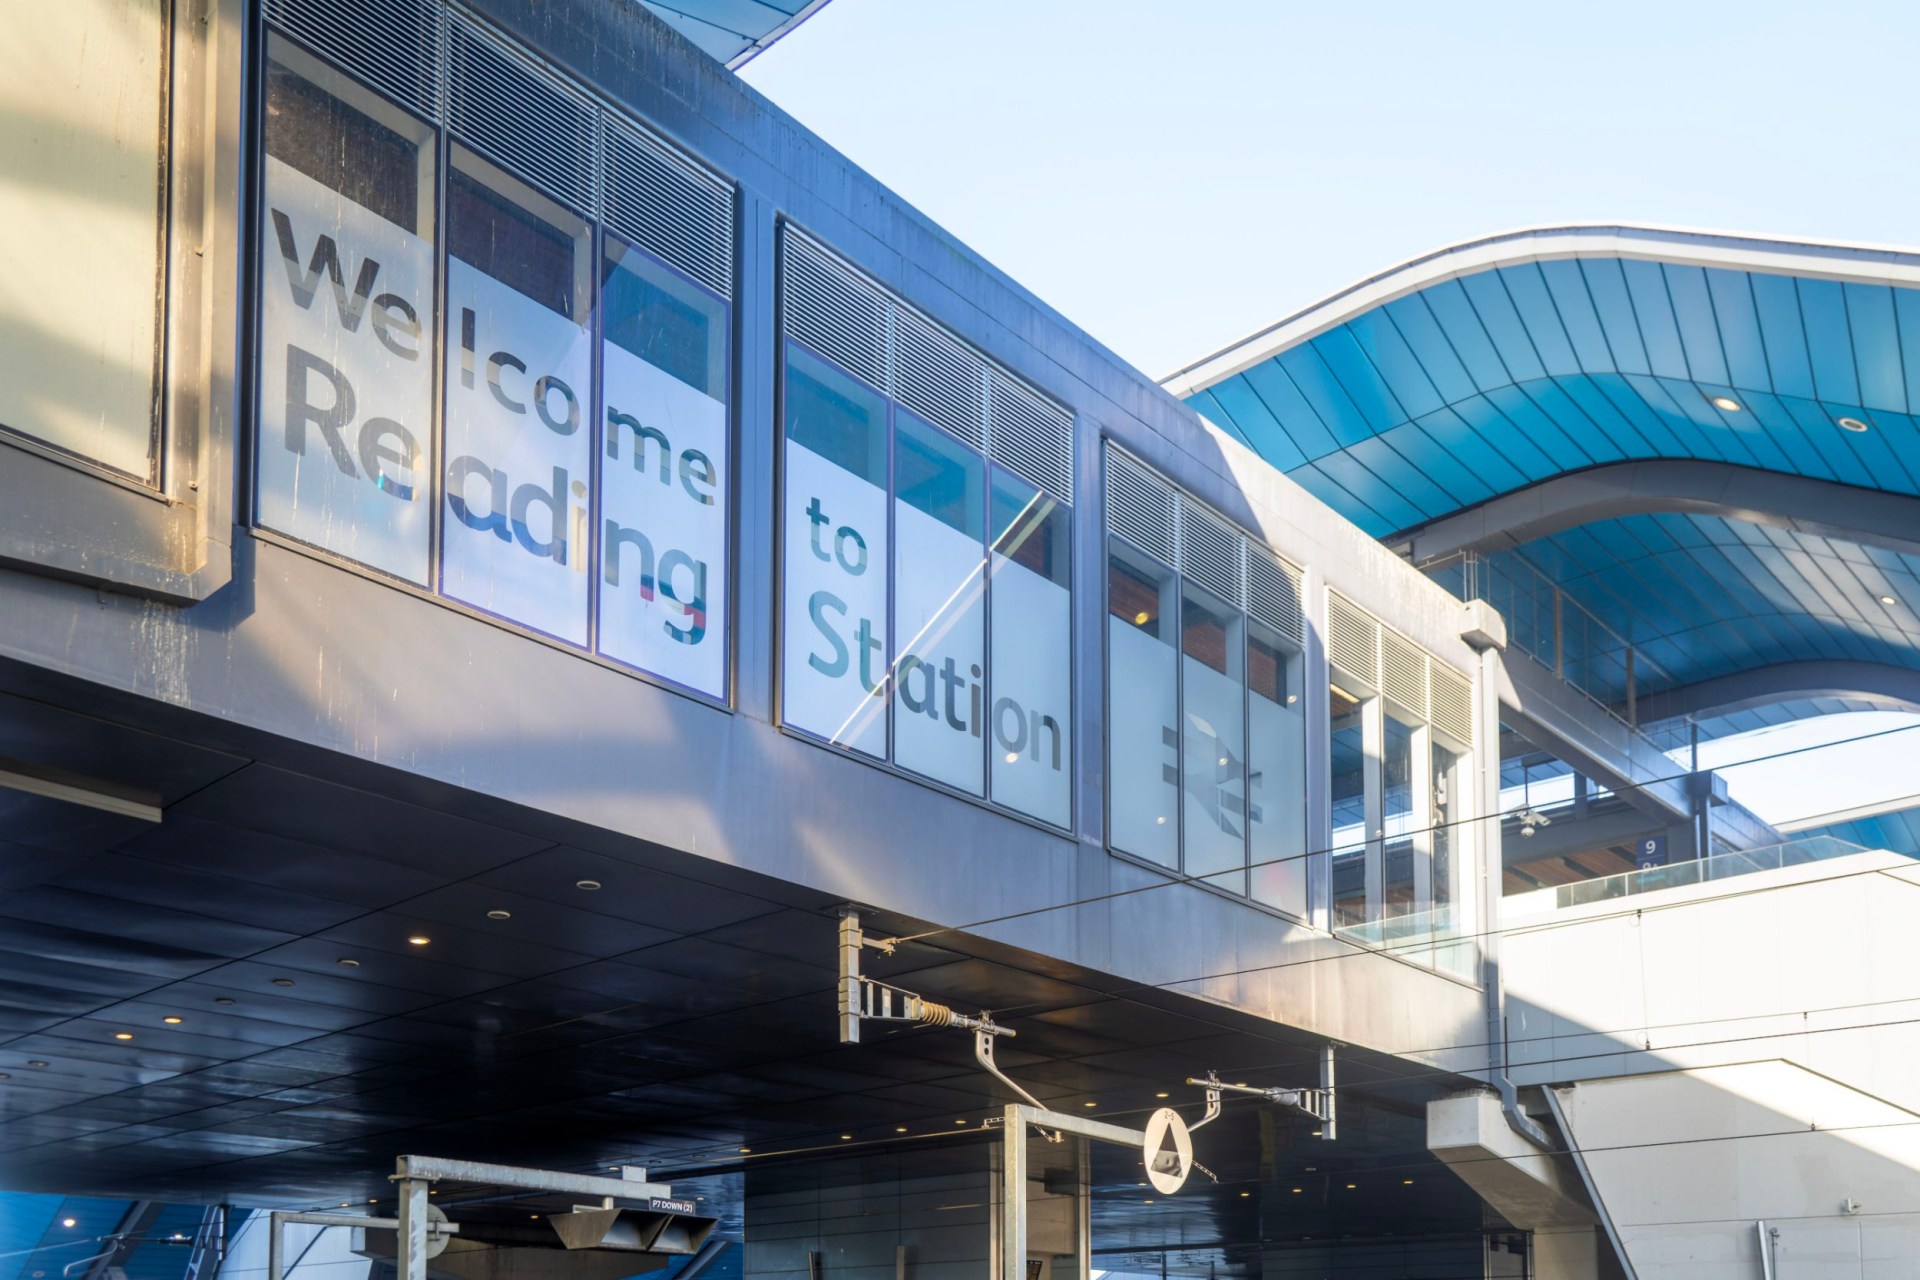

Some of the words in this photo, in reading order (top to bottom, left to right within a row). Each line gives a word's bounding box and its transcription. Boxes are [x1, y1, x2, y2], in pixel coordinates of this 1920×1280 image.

[271, 207, 717, 506] Welcome
[806, 497, 868, 576] to
[284, 343, 708, 645] Reading
[808, 590, 1061, 772] Station
[1645, 840, 1656, 854] 9
[652, 1199, 661, 1208] P7
[661, 1201, 683, 1211] DOWN
[683, 1203, 693, 1213] (2)
